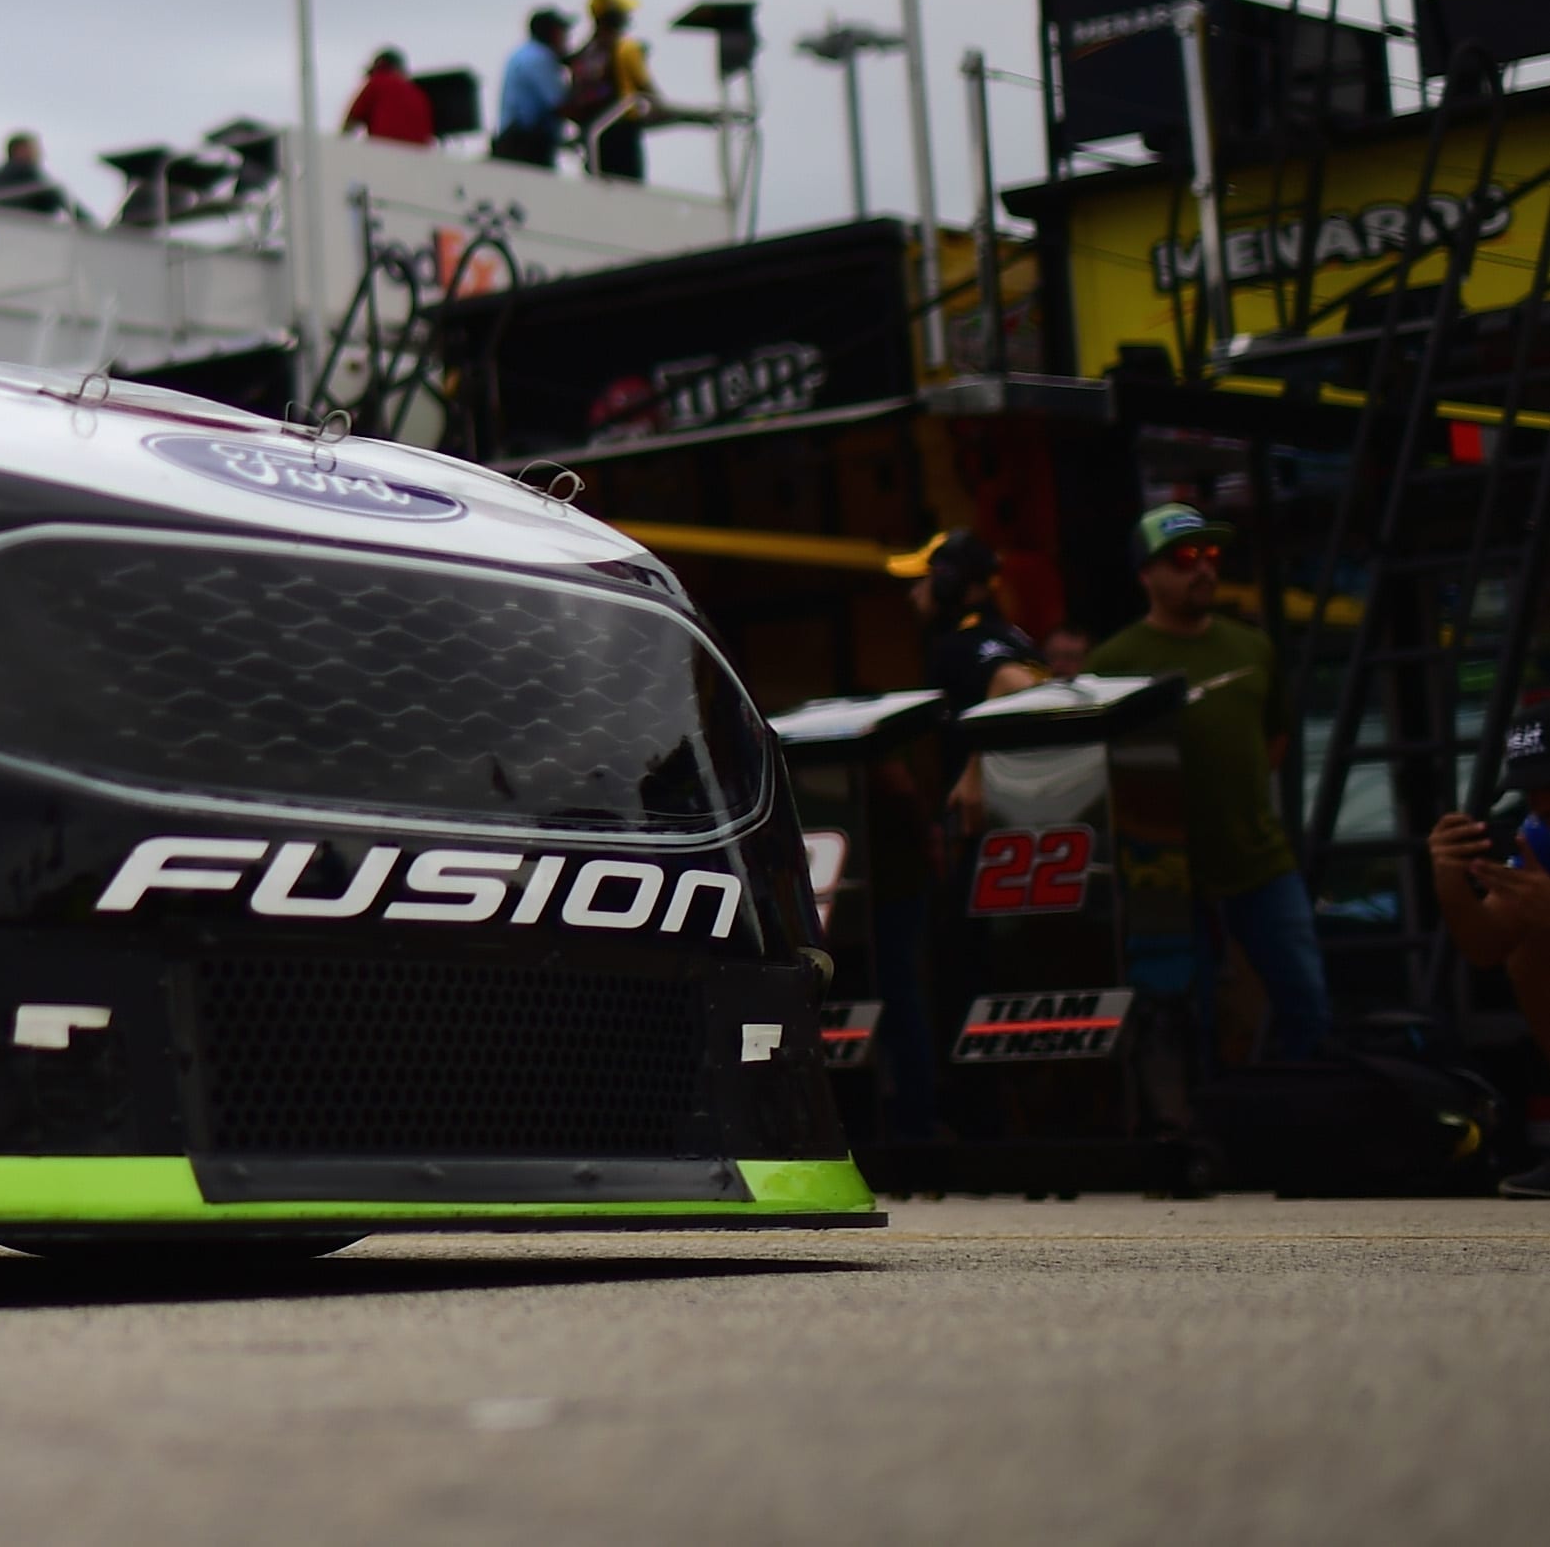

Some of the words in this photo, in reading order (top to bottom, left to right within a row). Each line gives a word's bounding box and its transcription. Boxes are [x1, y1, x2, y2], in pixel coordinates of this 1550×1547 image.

[96, 836, 743, 939] FUSION
[970, 826, 1093, 914] 22
[986, 994, 1099, 1022] TEAM
[957, 1028, 1111, 1058] PENSKE
